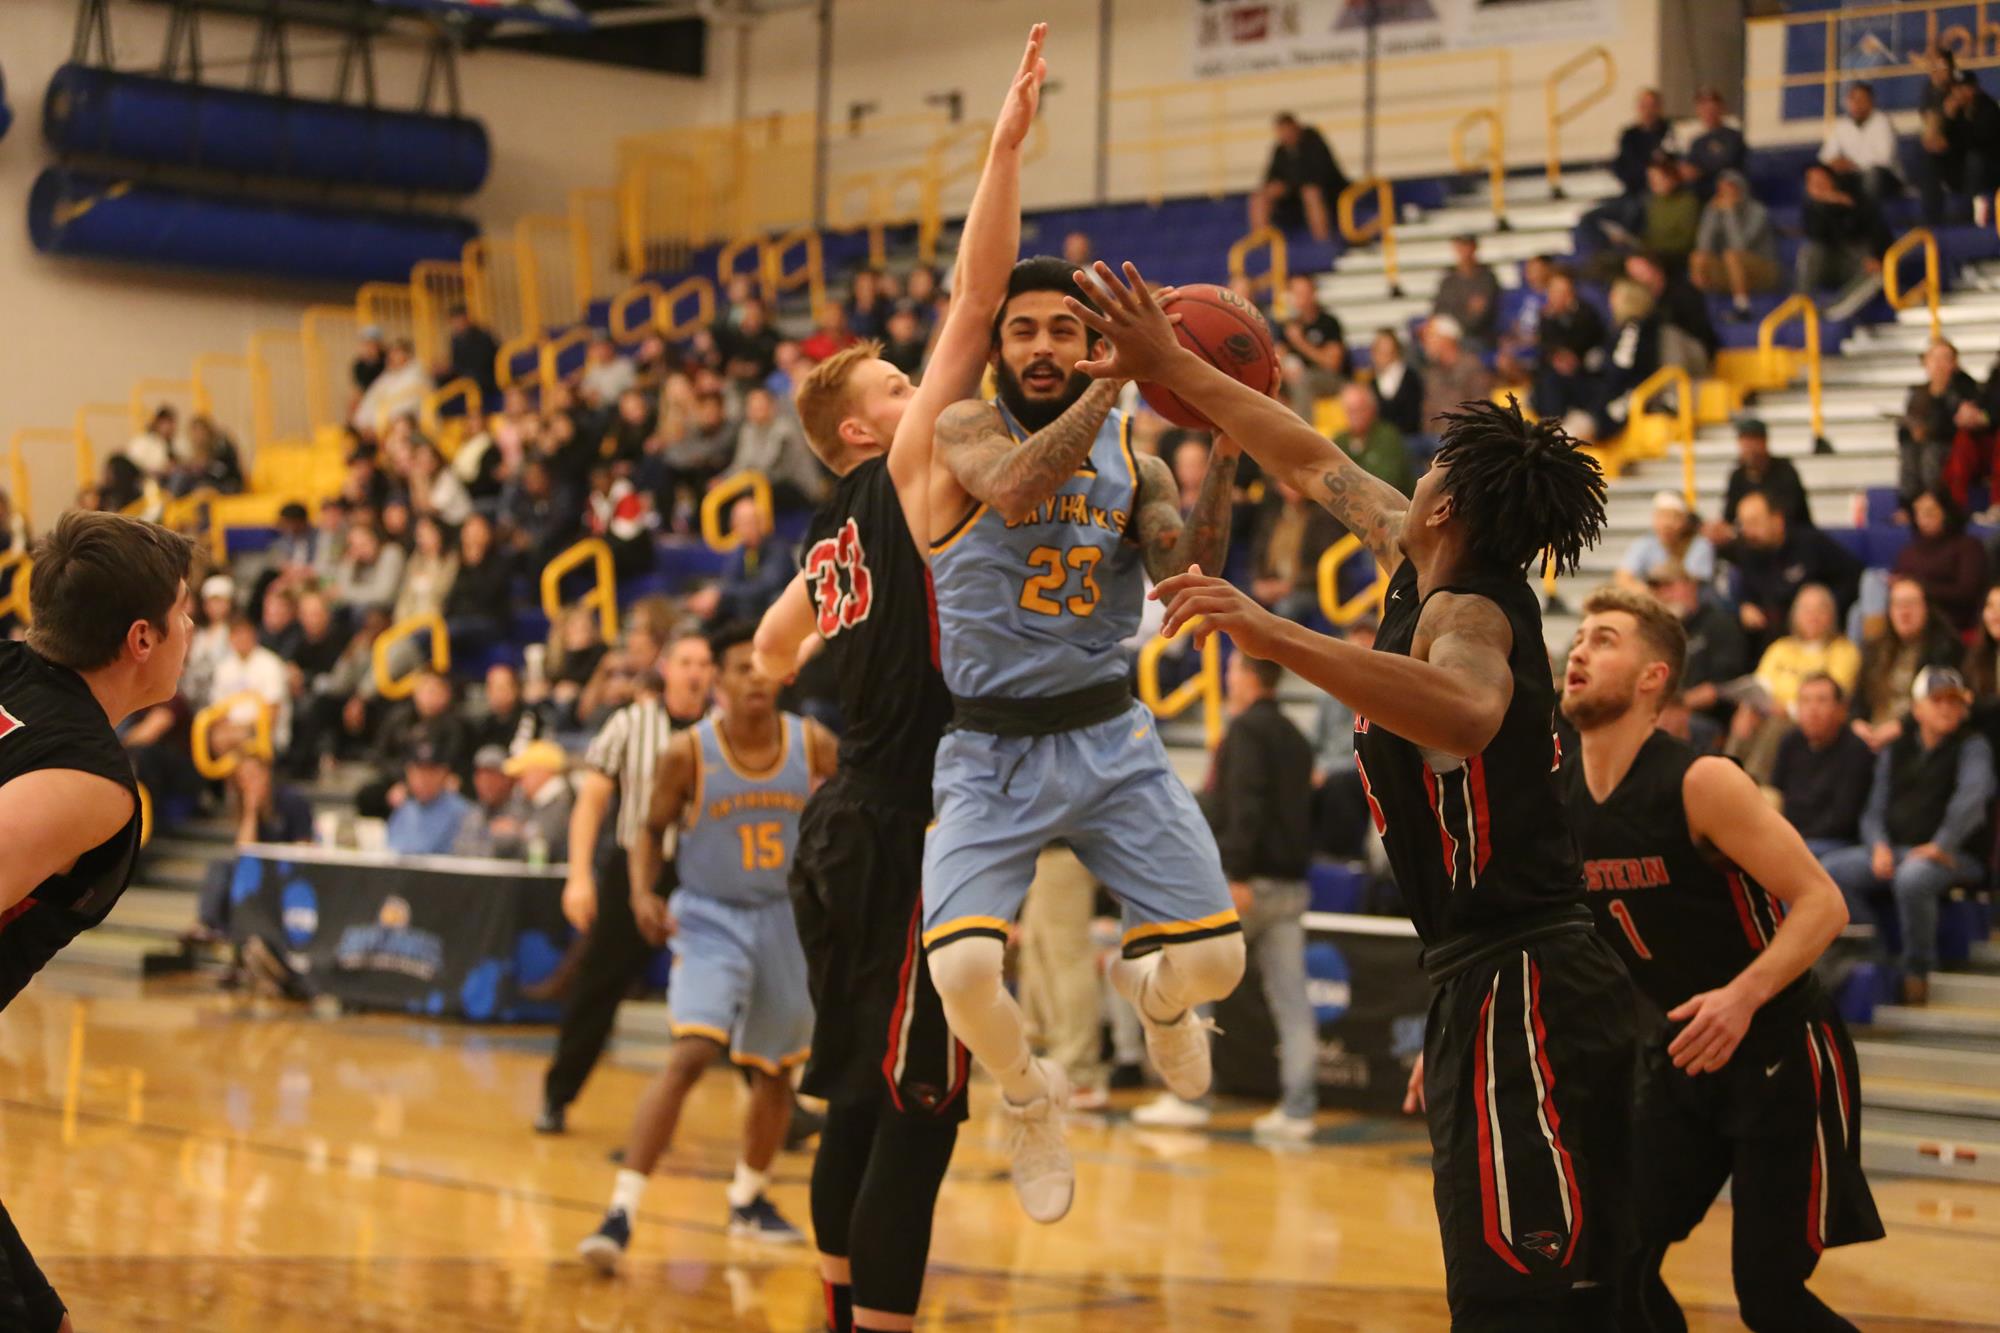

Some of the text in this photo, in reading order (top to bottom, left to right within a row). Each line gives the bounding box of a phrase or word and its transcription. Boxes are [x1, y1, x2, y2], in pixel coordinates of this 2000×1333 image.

[804, 516, 873, 639] 33
[1018, 545, 1104, 617] 23
[736, 819, 785, 872] 15
[1582, 855, 1671, 891] STERN
[1607, 898, 1653, 960] 1
